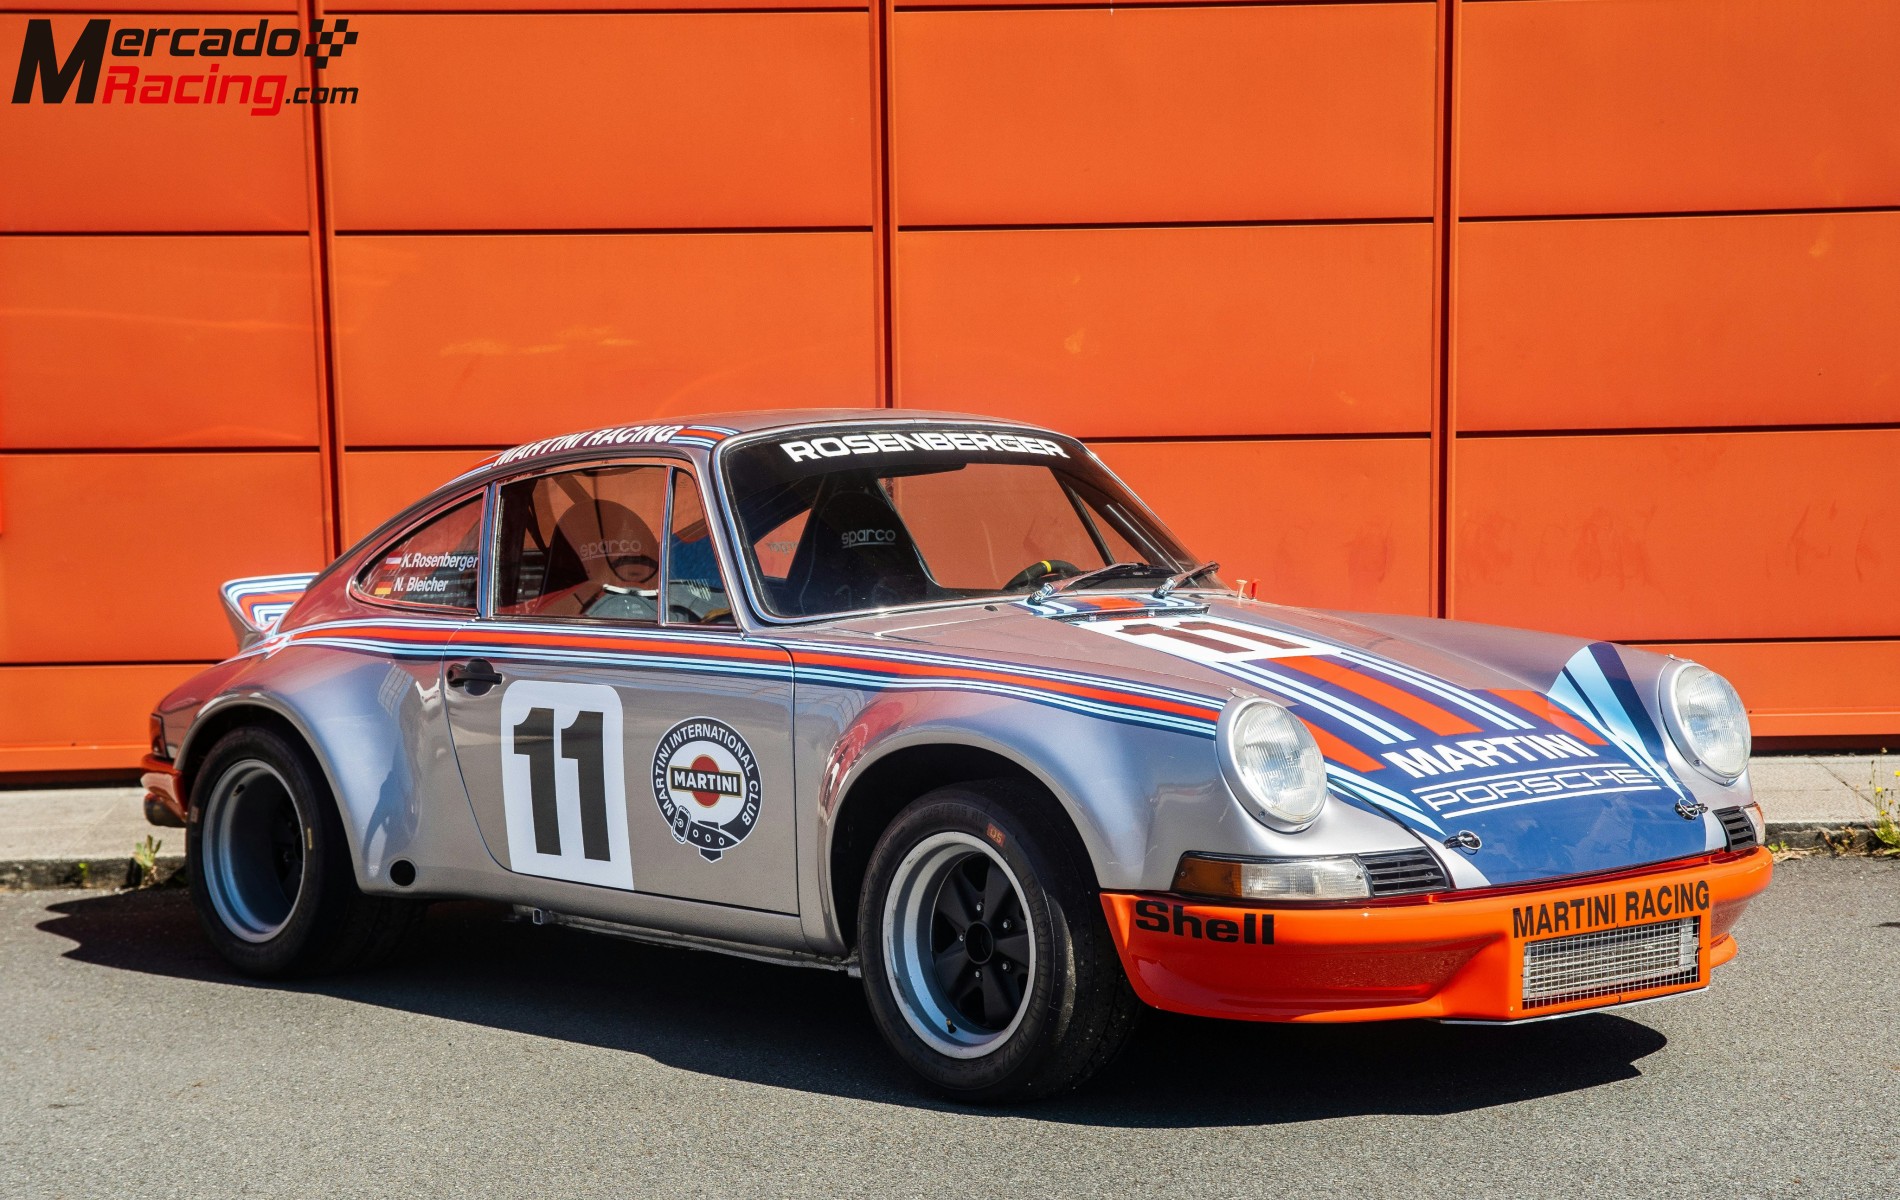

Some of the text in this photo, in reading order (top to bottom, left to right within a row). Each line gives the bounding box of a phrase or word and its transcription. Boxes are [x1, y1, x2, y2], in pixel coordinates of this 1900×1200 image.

[492, 425, 684, 467] MARTINI RACING
[779, 432, 1071, 463] ROSENBERGER
[580, 539, 641, 559] sparco
[841, 529, 896, 547] sparco
[393, 577, 448, 592] N. Bleicher
[1115, 620, 1311, 654] 11
[655, 723, 759, 826] MARTINI INTERNATIONAL CLUB
[1381, 734, 1600, 778] MARTINI
[513, 707, 611, 862] 11
[674, 770, 738, 793] MARTINI
[1420, 768, 1652, 811] PORSCHE
[1135, 899, 1275, 945] Shell
[1512, 880, 1710, 938] MARTINI RACING
